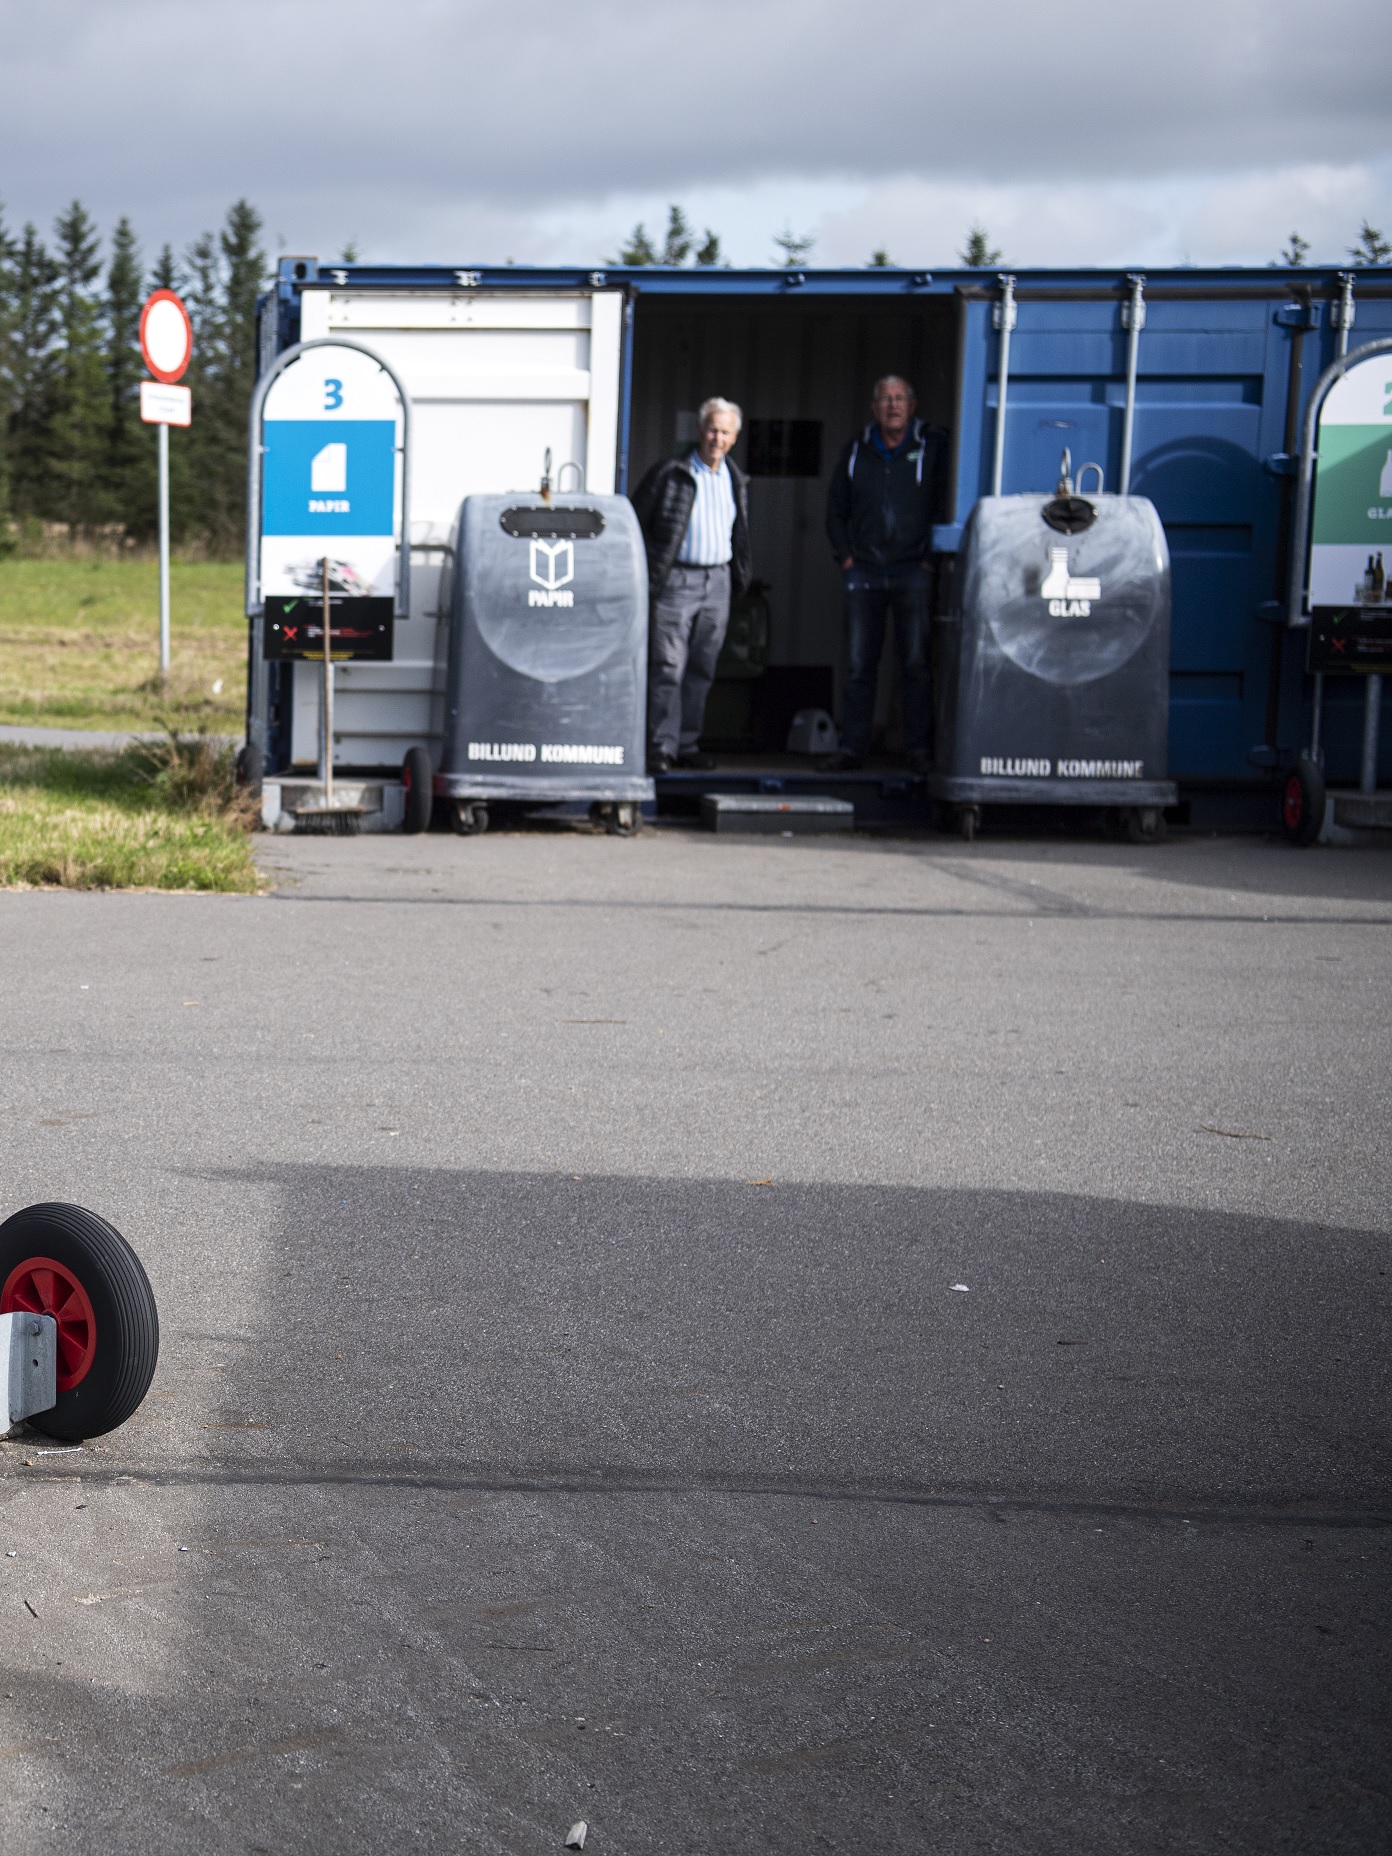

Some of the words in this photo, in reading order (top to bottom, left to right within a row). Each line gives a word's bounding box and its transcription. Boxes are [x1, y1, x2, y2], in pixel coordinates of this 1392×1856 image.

[324, 379, 344, 410] 3
[308, 499, 351, 513] PAPIR
[528, 589, 575, 608] PAPIR
[1048, 599, 1091, 618] GLAS
[468, 742, 537, 762] BILLUND
[540, 744, 625, 765] KOMMUNE
[980, 756, 1051, 777] BILLUND
[1057, 758, 1144, 779] KOMMUNE
